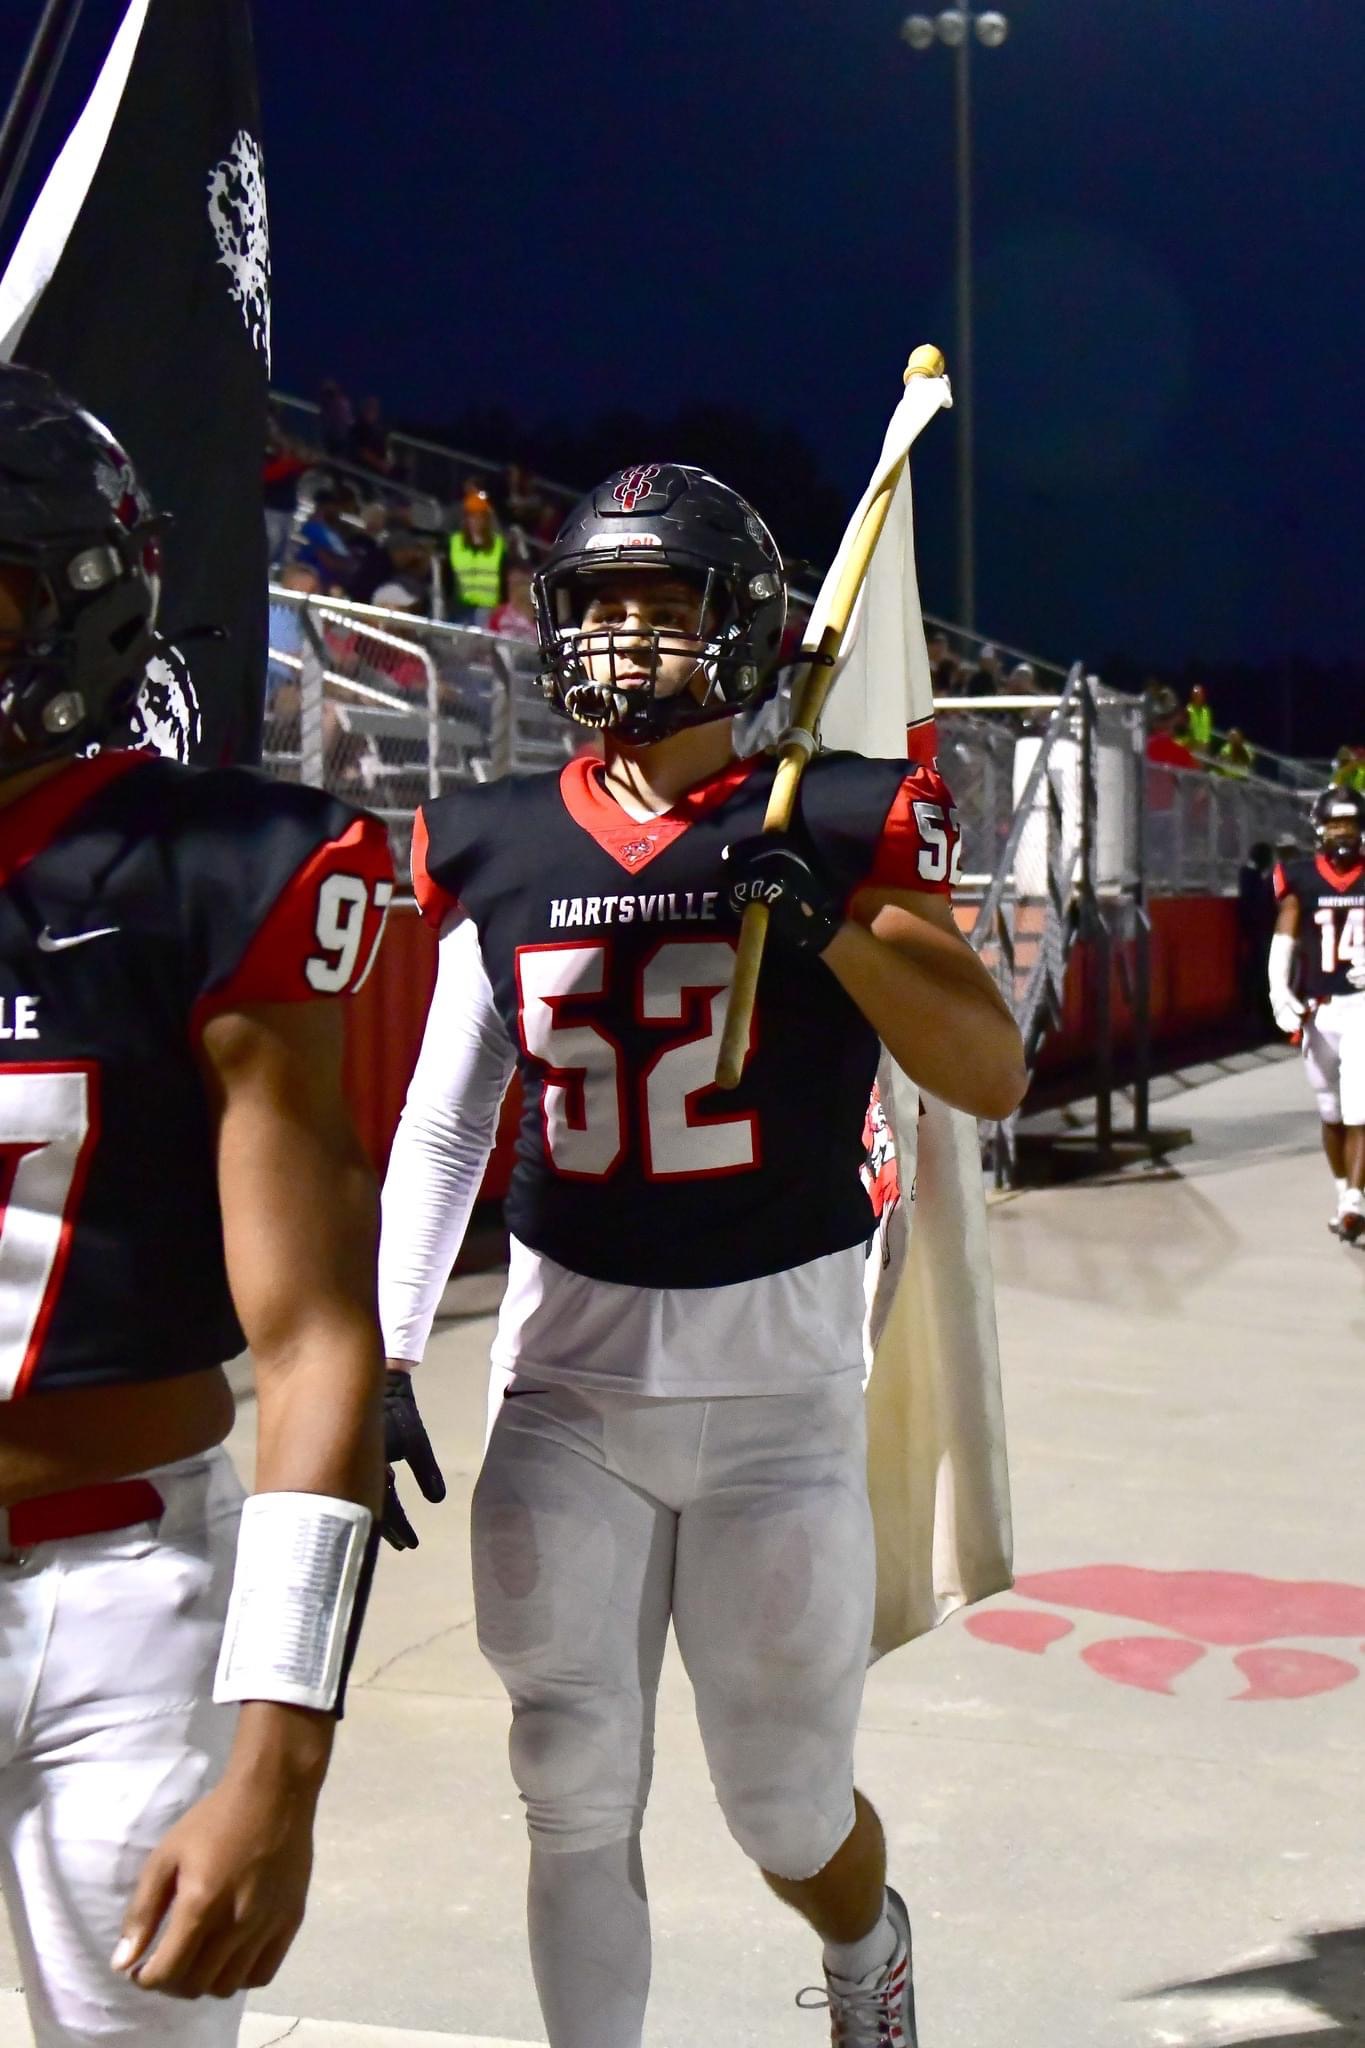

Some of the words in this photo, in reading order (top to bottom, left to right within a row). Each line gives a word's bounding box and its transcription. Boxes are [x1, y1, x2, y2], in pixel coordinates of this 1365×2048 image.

[305, 874, 393, 993] 97
[550, 891, 719, 928] HARTSVILLE
[1313, 907, 1365, 974] 14
[515, 940, 762, 1180] 52
